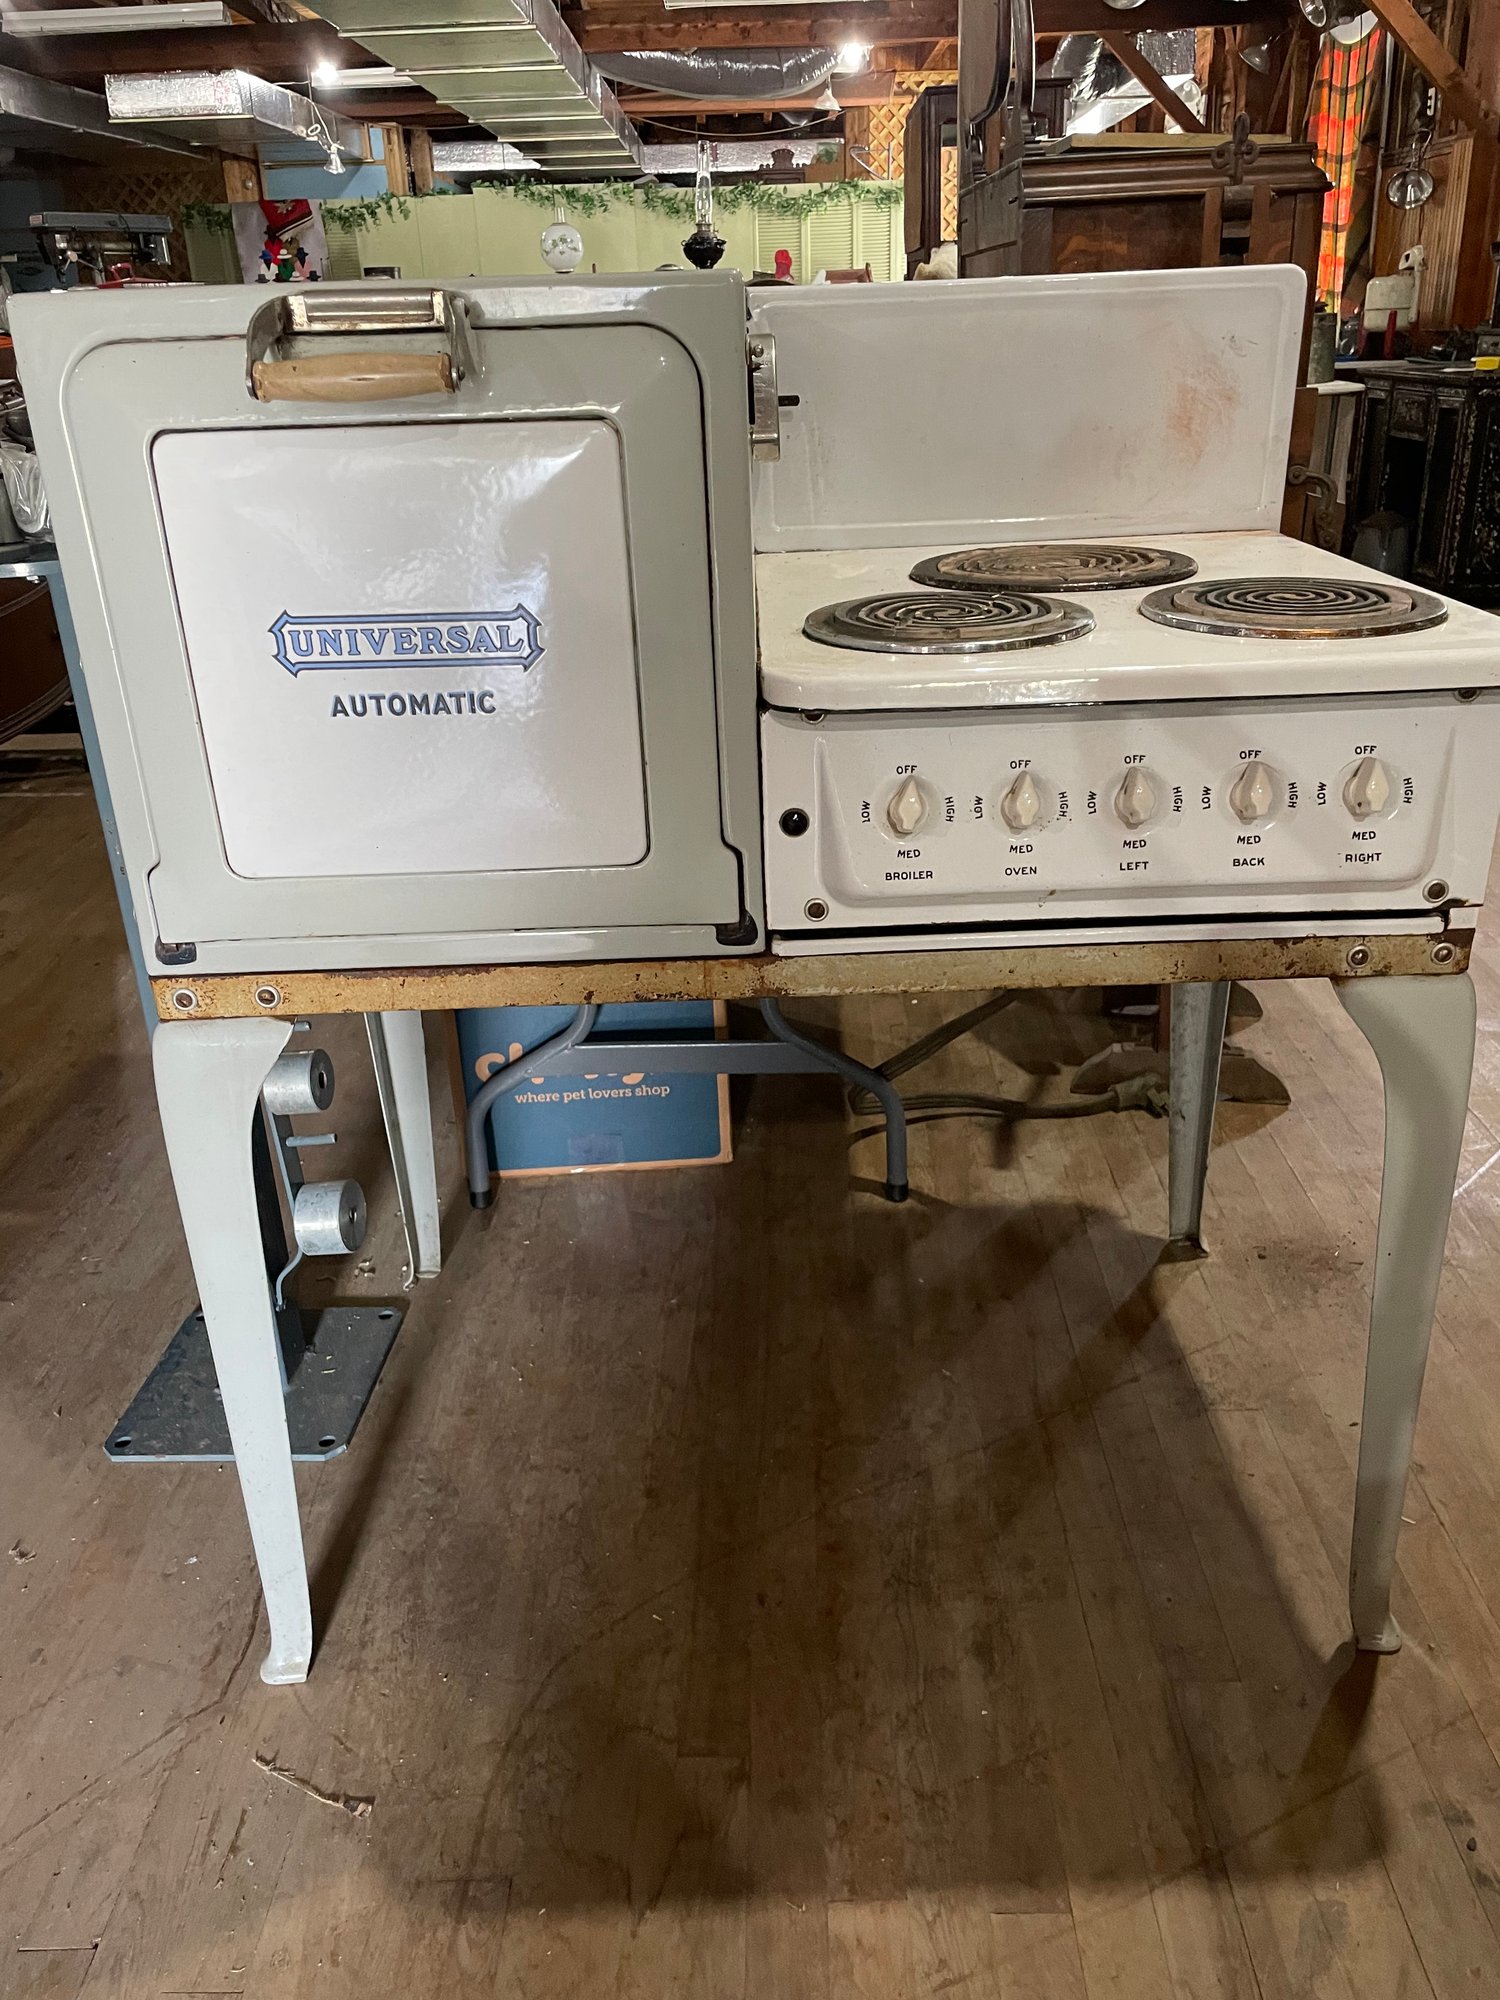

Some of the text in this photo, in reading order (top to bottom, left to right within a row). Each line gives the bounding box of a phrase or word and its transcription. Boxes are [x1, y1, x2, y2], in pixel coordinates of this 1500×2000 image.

[287, 625, 525, 657] UNIVERSAL
[331, 690, 497, 718] AUTOMATIC
[1238, 749, 1262, 760] OFF
[1354, 744, 1378, 756] OFF
[1009, 759, 1032, 770] OFF
[1123, 754, 1147, 765] OFF
[895, 764, 918, 776] OFF
[1287, 781, 1299, 809] HIGH
[1316, 781, 1328, 806] LOW
[1402, 777, 1414, 804] HIGH
[1087, 790, 1098, 815] LOW
[1172, 785, 1184, 813] HIGH
[1201, 785, 1212, 811] LOW
[944, 796, 956, 823] HIGH
[973, 795, 985, 820] LOW
[1057, 791, 1069, 819] HIGH
[860, 800, 871, 824] LOW
[1236, 834, 1262, 846] MED
[1351, 830, 1377, 841] MED
[1008, 843, 1034, 854] MED
[1122, 838, 1147, 850] MED
[896, 848, 921, 859] MED
[1344, 852, 1383, 864] RIGHT
[1119, 860, 1150, 872] LEFT
[1232, 856, 1266, 867] BACK
[884, 870, 934, 881] BROILER
[1004, 865, 1038, 877] OVEN
[514, 1084, 670, 1104] where pet lovers shop
